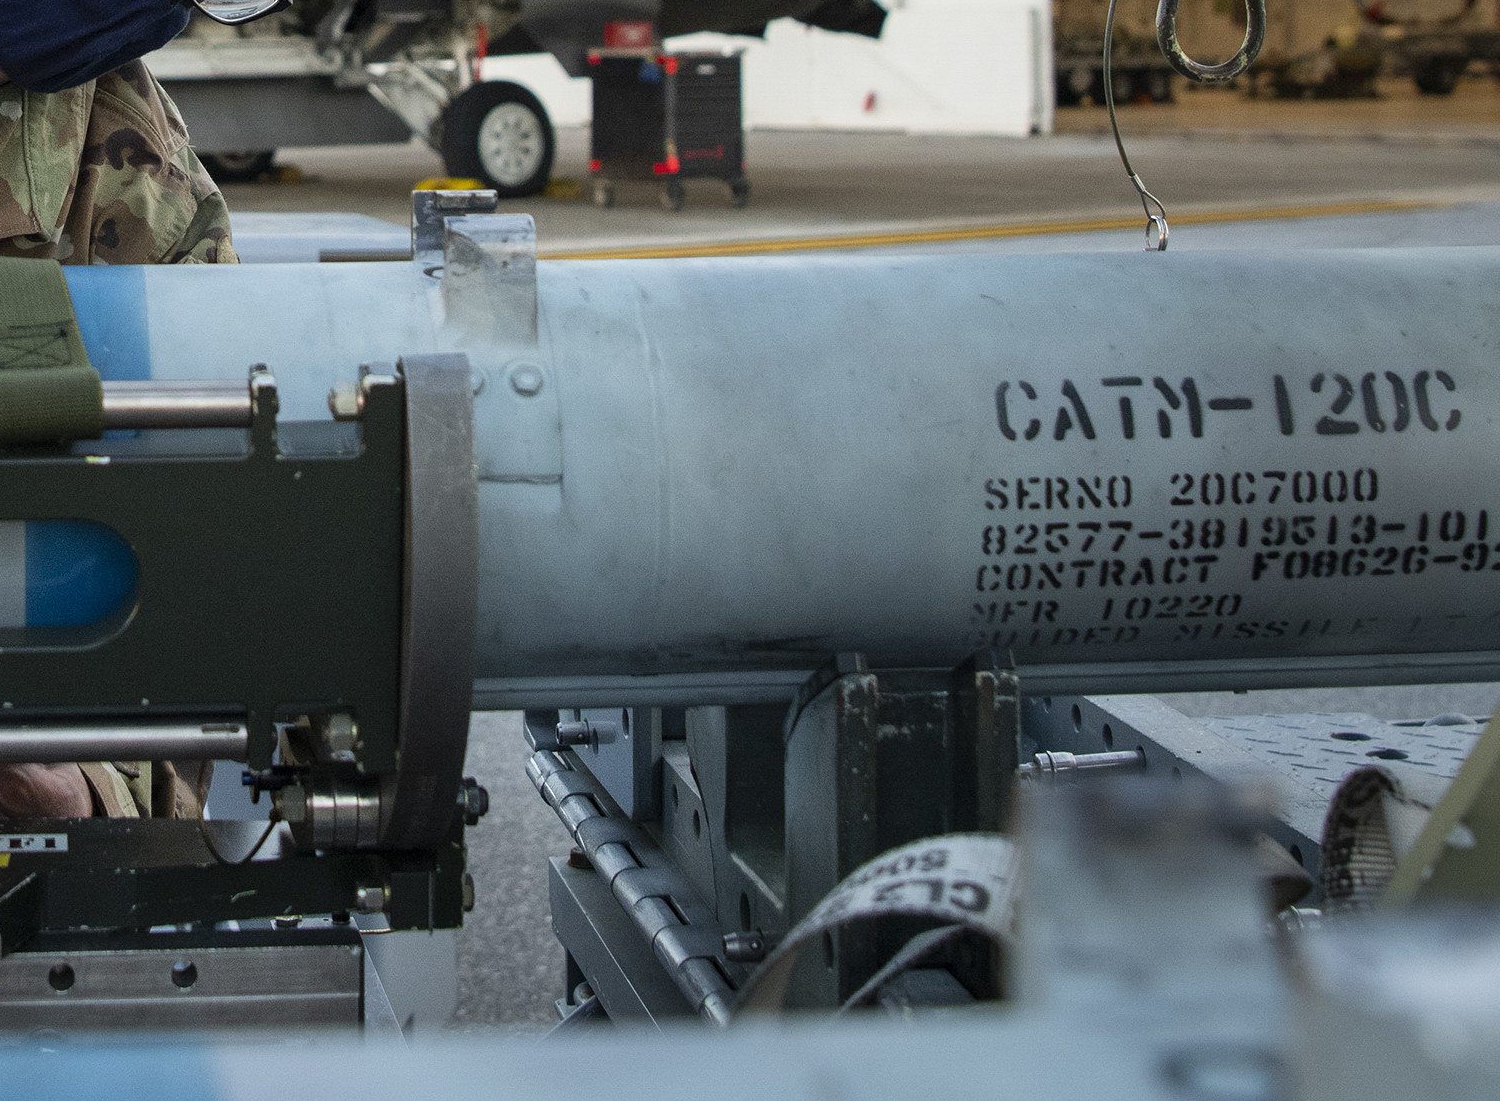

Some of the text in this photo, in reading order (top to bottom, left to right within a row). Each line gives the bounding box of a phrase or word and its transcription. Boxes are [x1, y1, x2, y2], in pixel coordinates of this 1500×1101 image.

[995, 370, 1462, 441] CATM-120C
[984, 468, 1379, 509] SERNO 20C7000
[982, 510, 1489, 555] 82577-3819513-101
[975, 555, 1219, 591] CONTRACT
[969, 593, 1243, 623] MFR 10220
